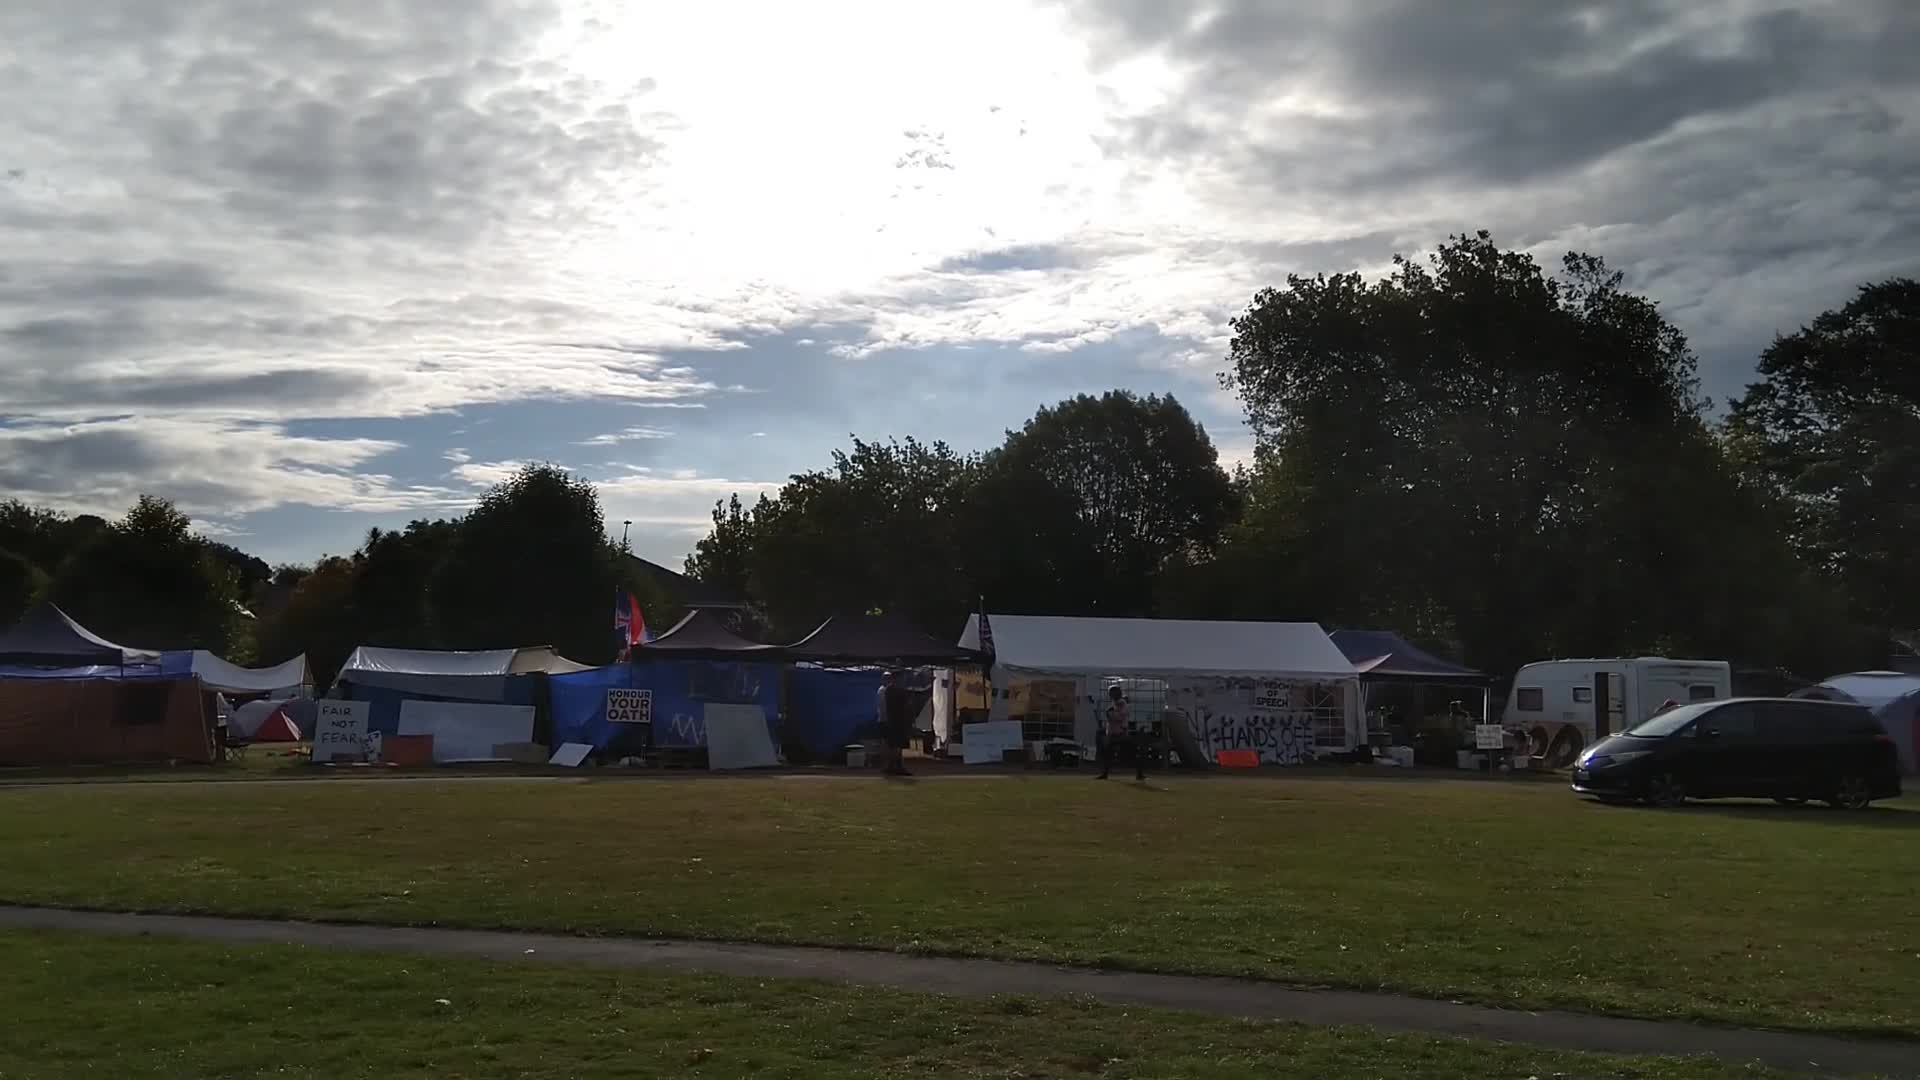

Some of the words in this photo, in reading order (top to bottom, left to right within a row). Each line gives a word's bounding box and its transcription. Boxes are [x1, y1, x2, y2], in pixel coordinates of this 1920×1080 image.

[609, 690, 650, 699] HONOUR
[609, 699, 650, 709] YOUR
[1256, 696, 1288, 708] SPEECH
[322, 706, 352, 716] FAIR
[608, 709, 649, 720] OATH
[332, 720, 357, 728] NOT
[321, 732, 359, 744] FEAR
[1219, 727, 1278, 750] HANDS
